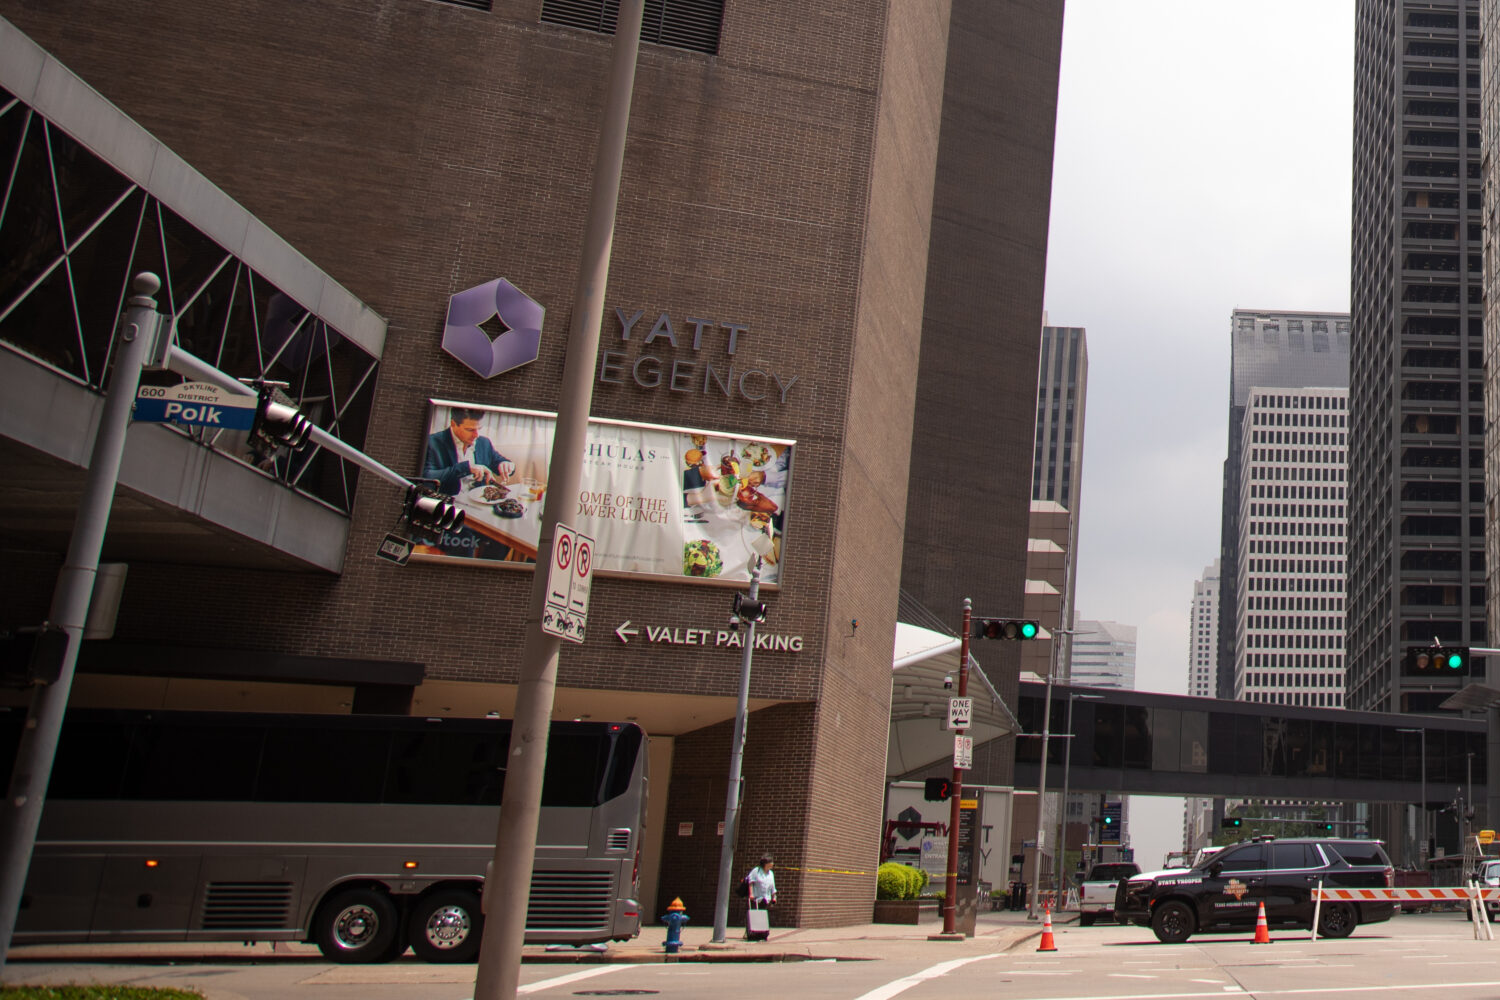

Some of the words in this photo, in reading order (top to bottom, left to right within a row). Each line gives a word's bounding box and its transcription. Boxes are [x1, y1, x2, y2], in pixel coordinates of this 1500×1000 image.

[615, 306, 749, 355] YATT
[600, 349, 800, 404] EGENCY
[141, 388, 166, 397] 600
[177, 393, 219, 402] DISTRICT
[183, 383, 219, 394] SKYLINE
[164, 402, 223, 423] Polk
[584, 443, 656, 463] HULAS
[580, 490, 612, 506] OME
[615, 495, 634, 508] OF
[637, 497, 667, 511] THE
[577, 502, 616, 519] OWER
[620, 508, 669, 524] LUNCH
[646, 625, 711, 645] VALET
[951, 708, 970, 717] WAY
[952, 700, 970, 708] ONE
